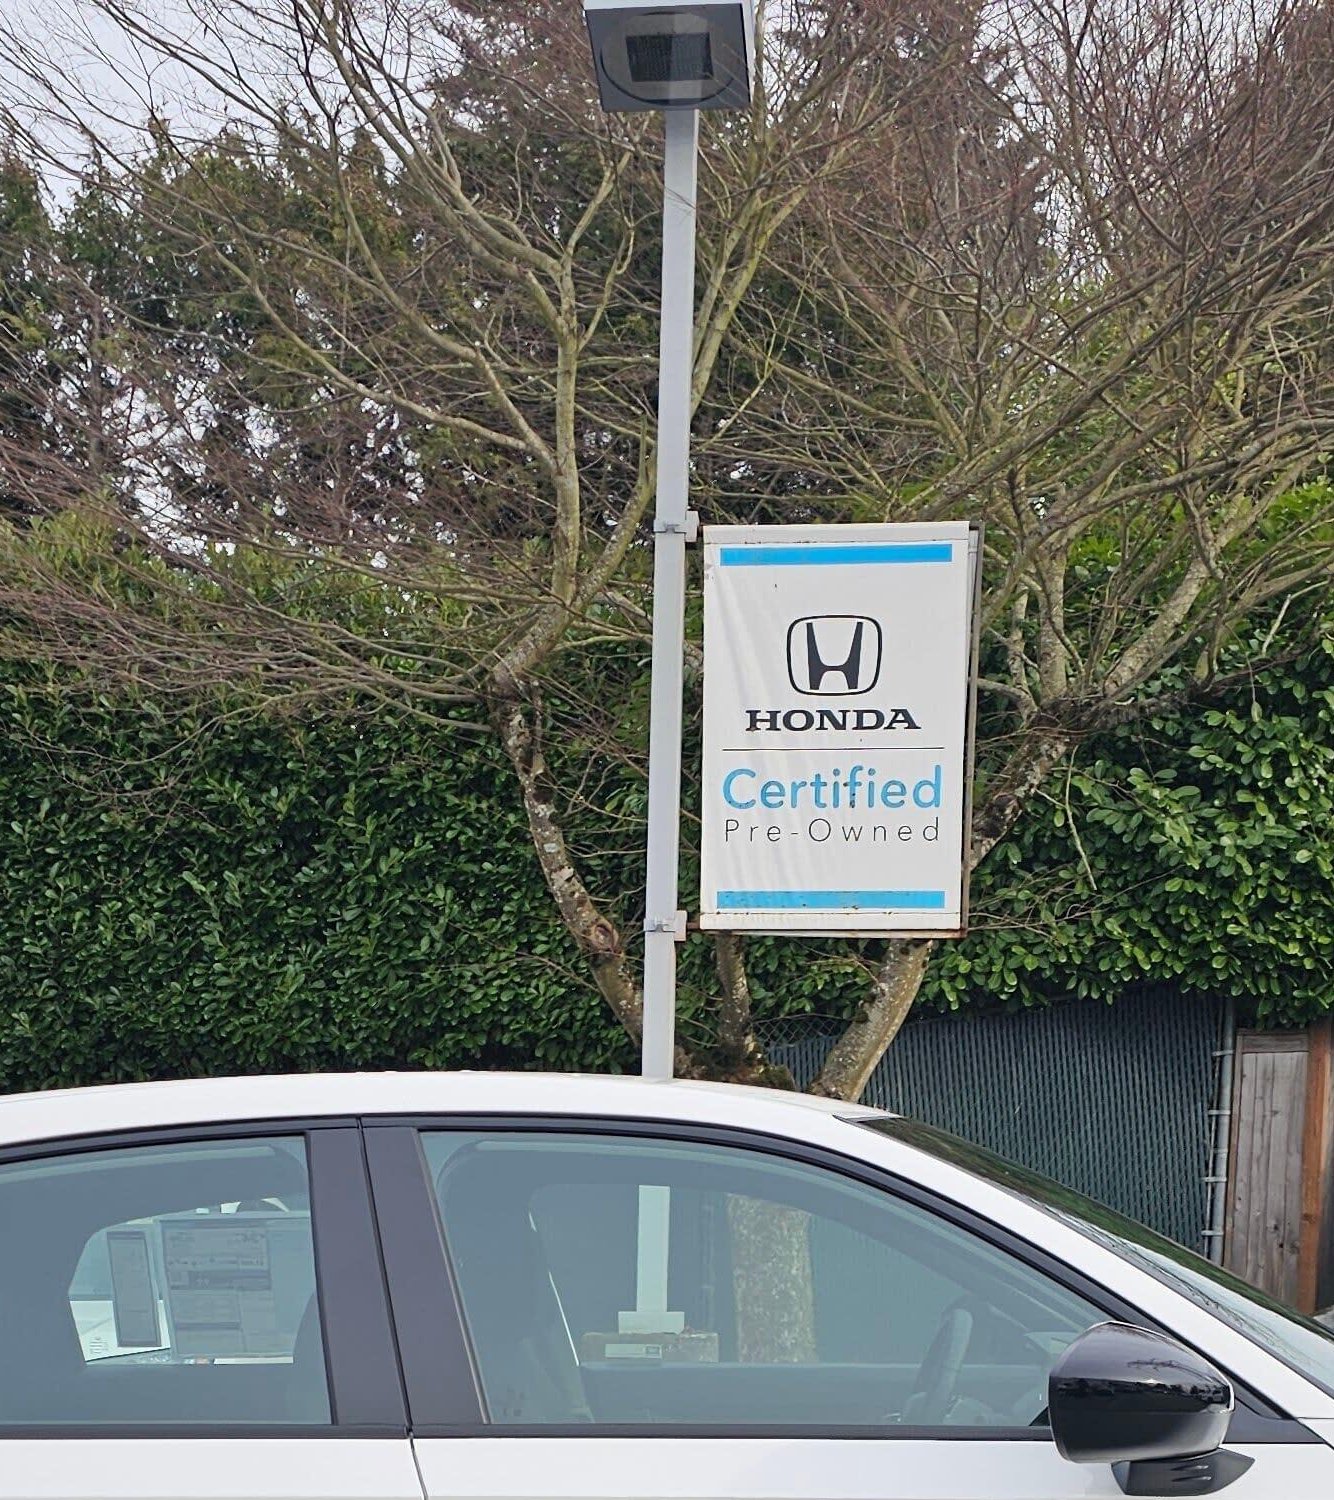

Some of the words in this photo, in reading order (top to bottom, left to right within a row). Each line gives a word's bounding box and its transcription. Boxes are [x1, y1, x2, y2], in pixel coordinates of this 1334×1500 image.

[745, 708, 921, 732] HONDA
[722, 764, 942, 809] Certified
[725, 816, 939, 842] Pre-Owned
